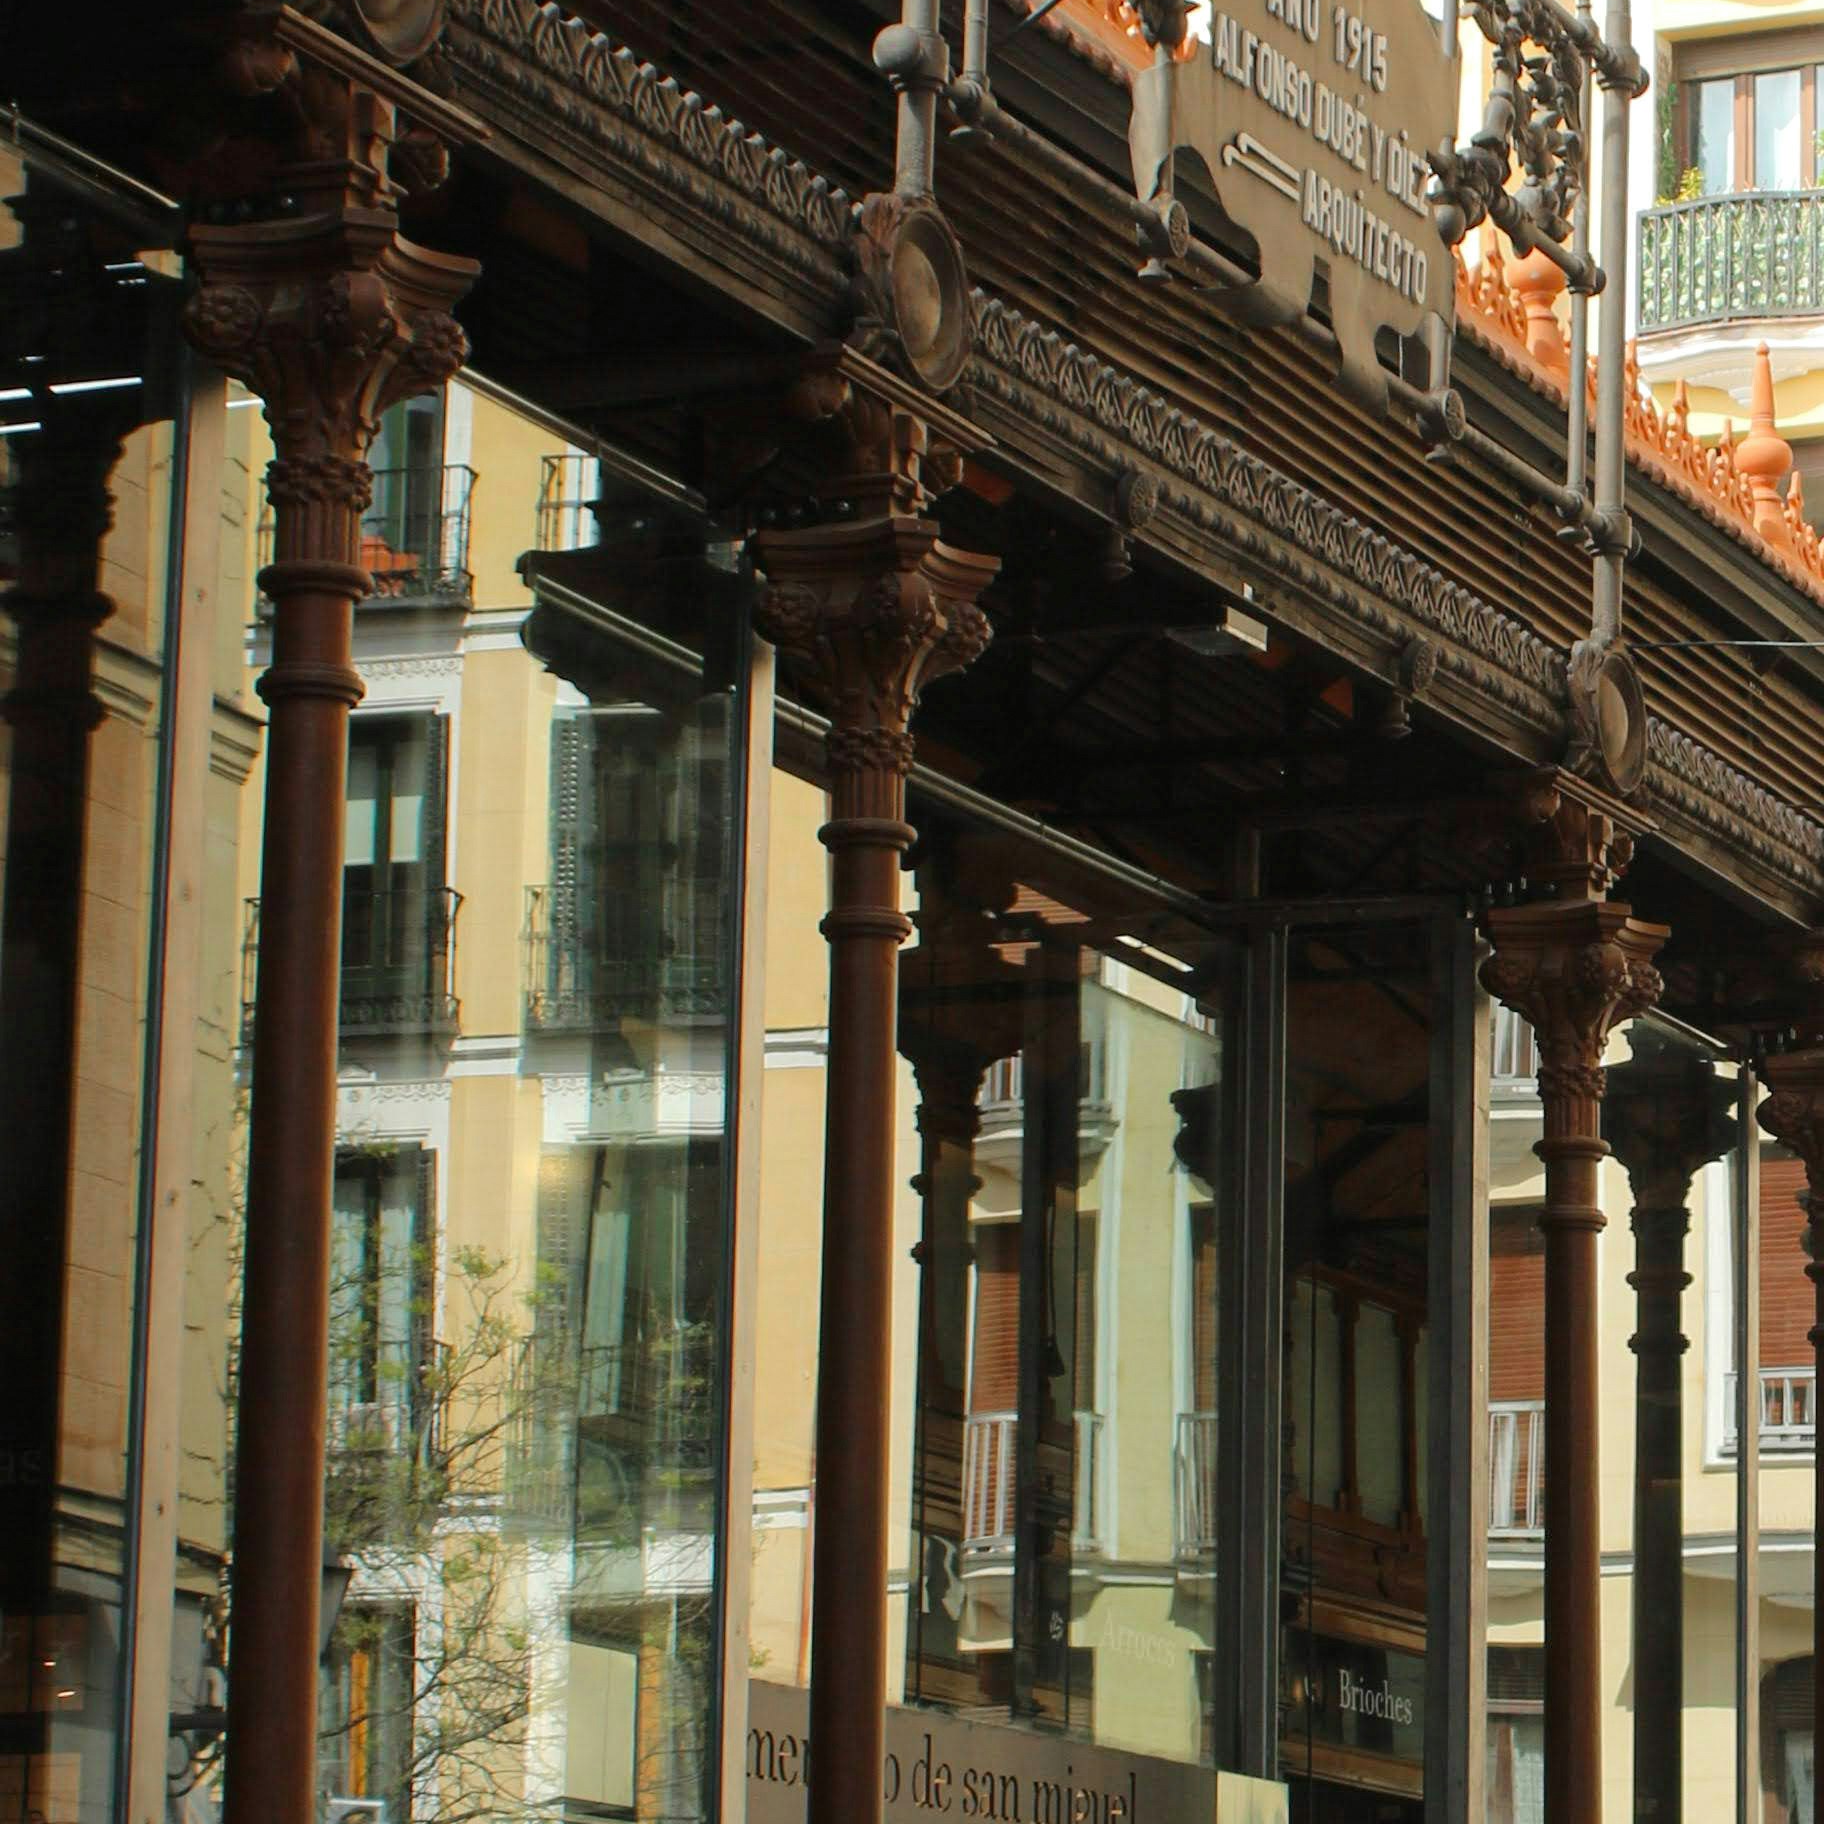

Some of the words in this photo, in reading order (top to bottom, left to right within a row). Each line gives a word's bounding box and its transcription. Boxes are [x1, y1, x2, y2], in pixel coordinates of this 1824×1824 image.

[1334, 5, 1388, 93] 1915
[1213, 11, 1314, 129] ALFONSO
[1312, 80, 1368, 172] DUBÉ
[1369, 122, 1385, 184] Y
[1338, 1668, 1414, 1726] Brioches
[912, 1734, 953, 1813] de
[962, 1767, 1021, 1824] san
